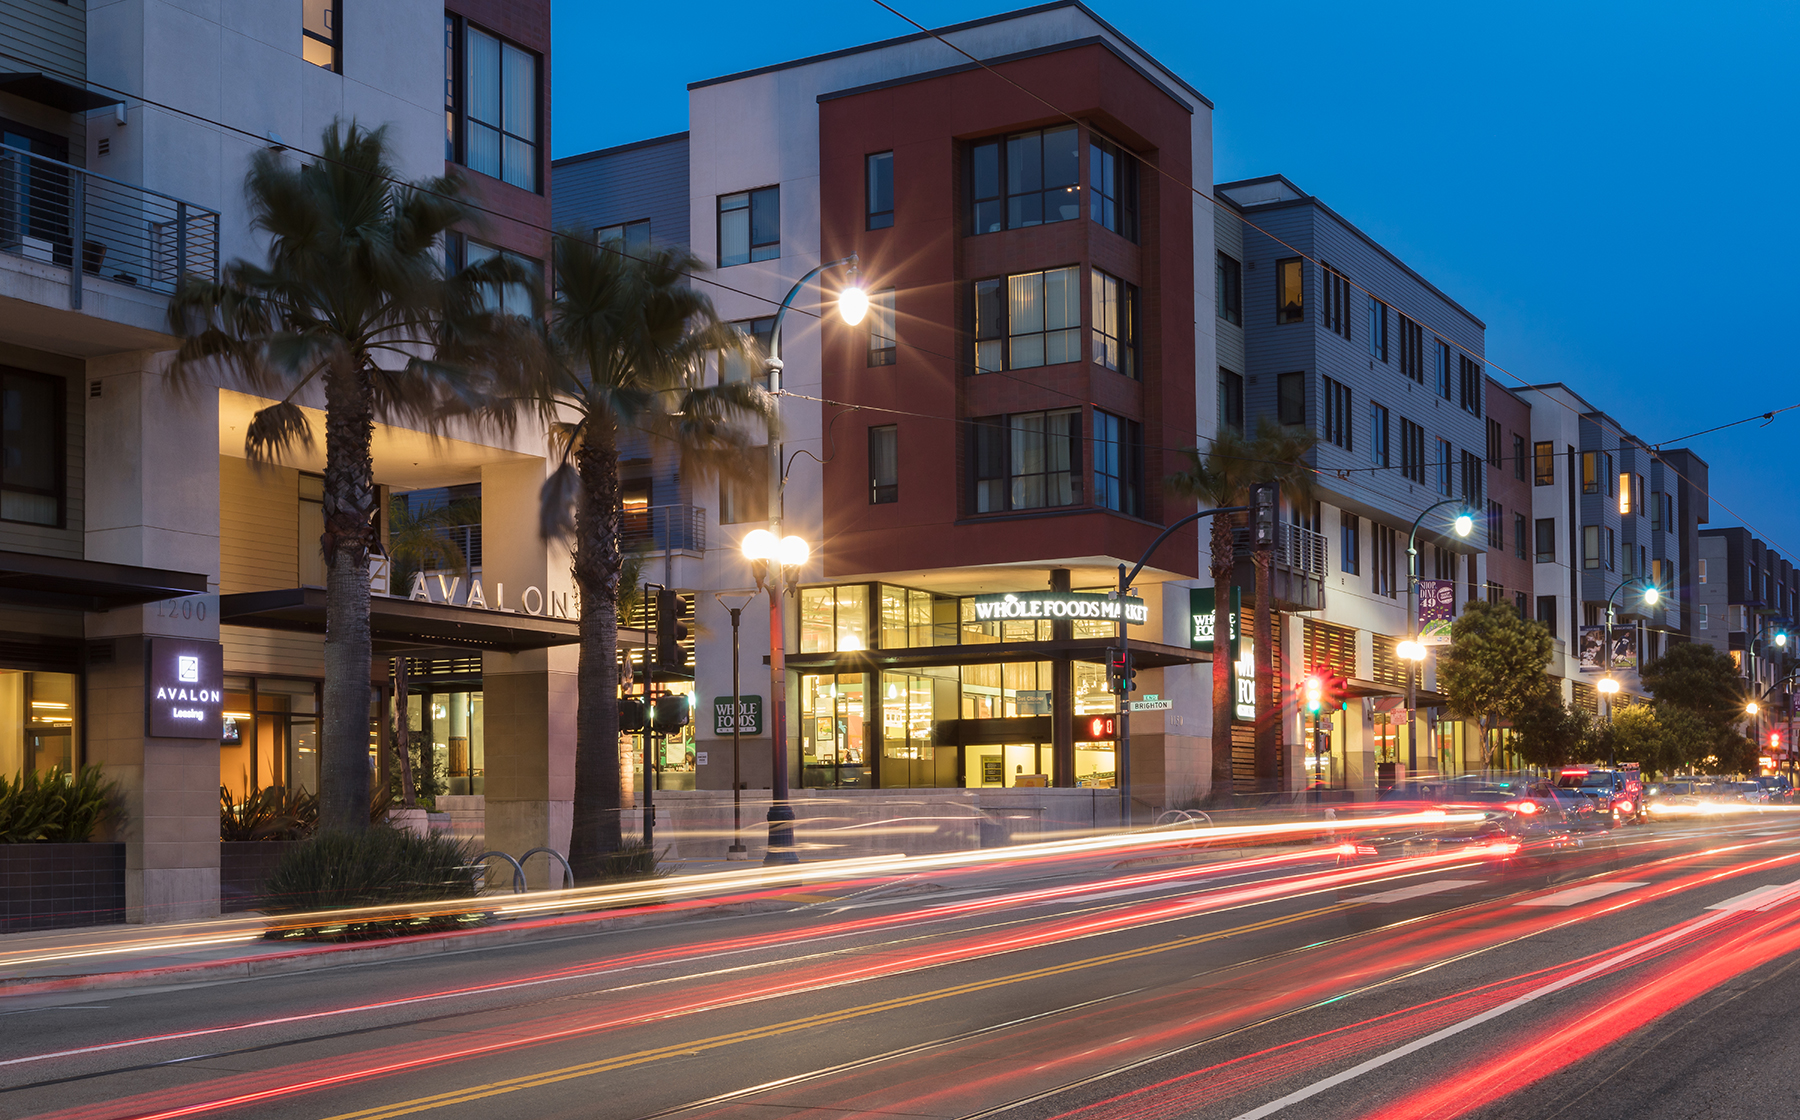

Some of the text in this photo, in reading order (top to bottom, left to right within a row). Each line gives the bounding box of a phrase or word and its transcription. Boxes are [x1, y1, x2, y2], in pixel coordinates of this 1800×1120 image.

[409, 571, 569, 619] AVALON
[1420, 590, 1436, 599] DINE
[157, 599, 206, 621] 1200
[975, 594, 1043, 619] WHOLE
[1043, 601, 1100, 618] FOODS
[1420, 598, 1437, 608] 49
[1193, 612, 1236, 626] WHE
[157, 687, 220, 702] AVALON
[173, 708, 204, 721] Leasing
